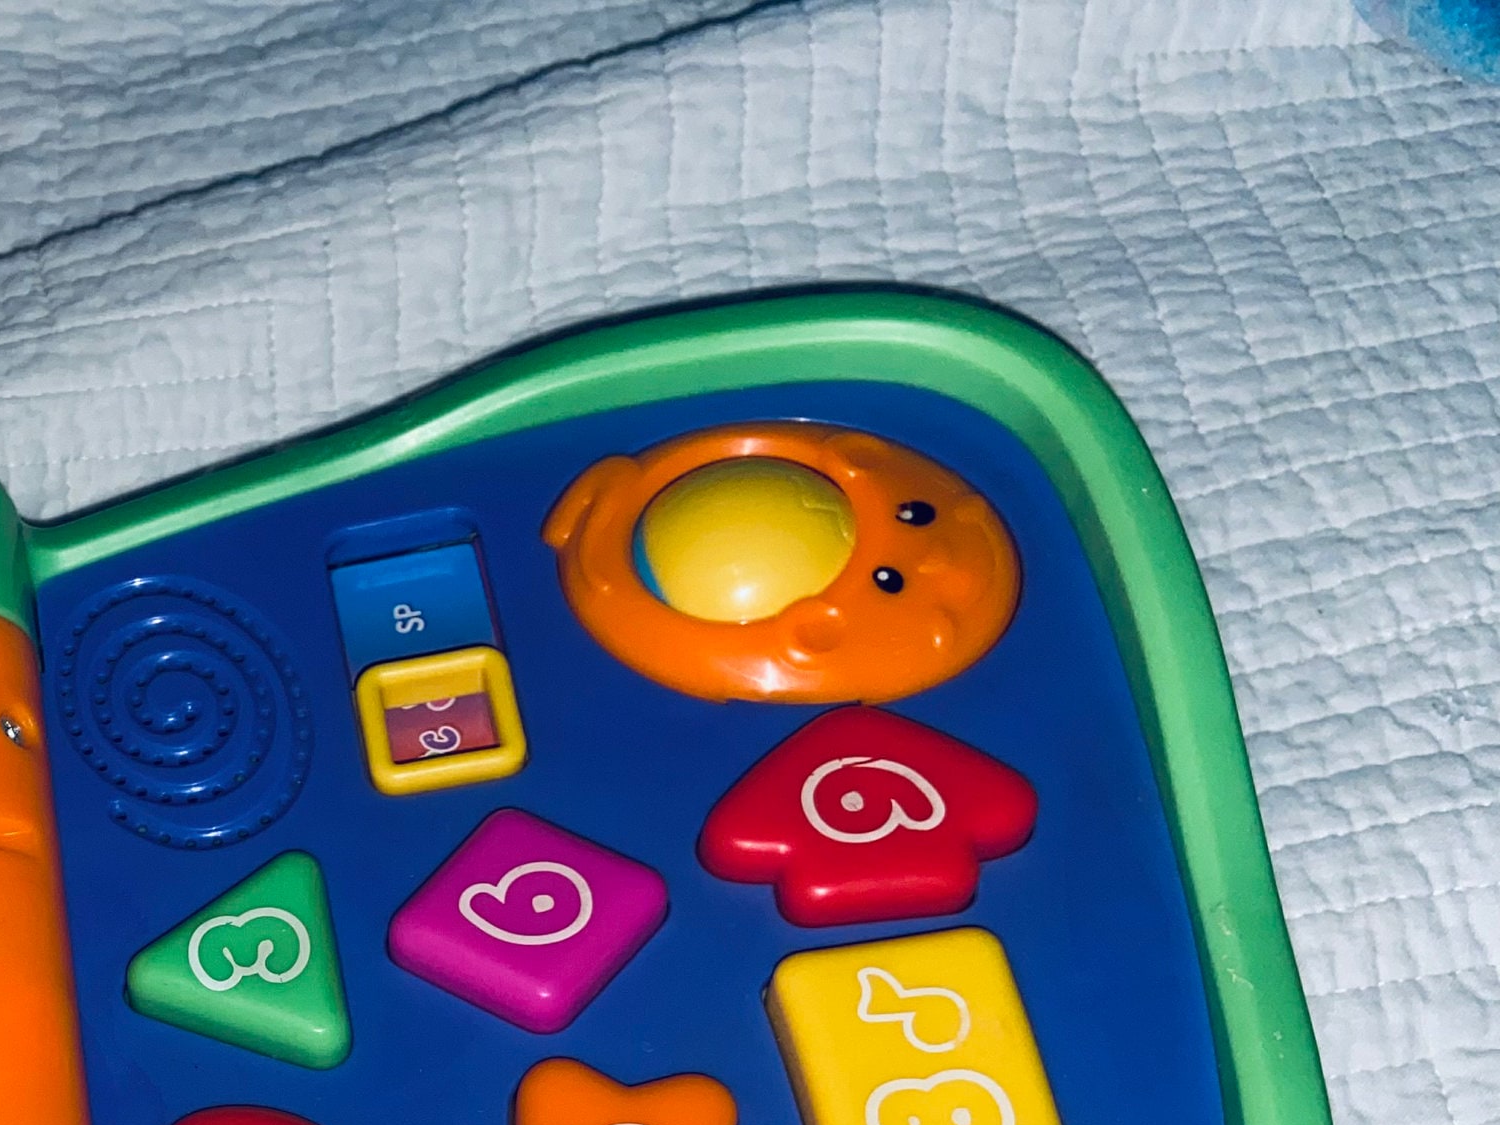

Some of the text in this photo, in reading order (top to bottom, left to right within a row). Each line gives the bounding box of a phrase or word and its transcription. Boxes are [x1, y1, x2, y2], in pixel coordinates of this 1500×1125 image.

[393, 604, 425, 633] SP
[419, 725, 460, 757] C
[800, 755, 947, 844] 9
[458, 861, 593, 946] 6
[187, 906, 311, 992] 3
